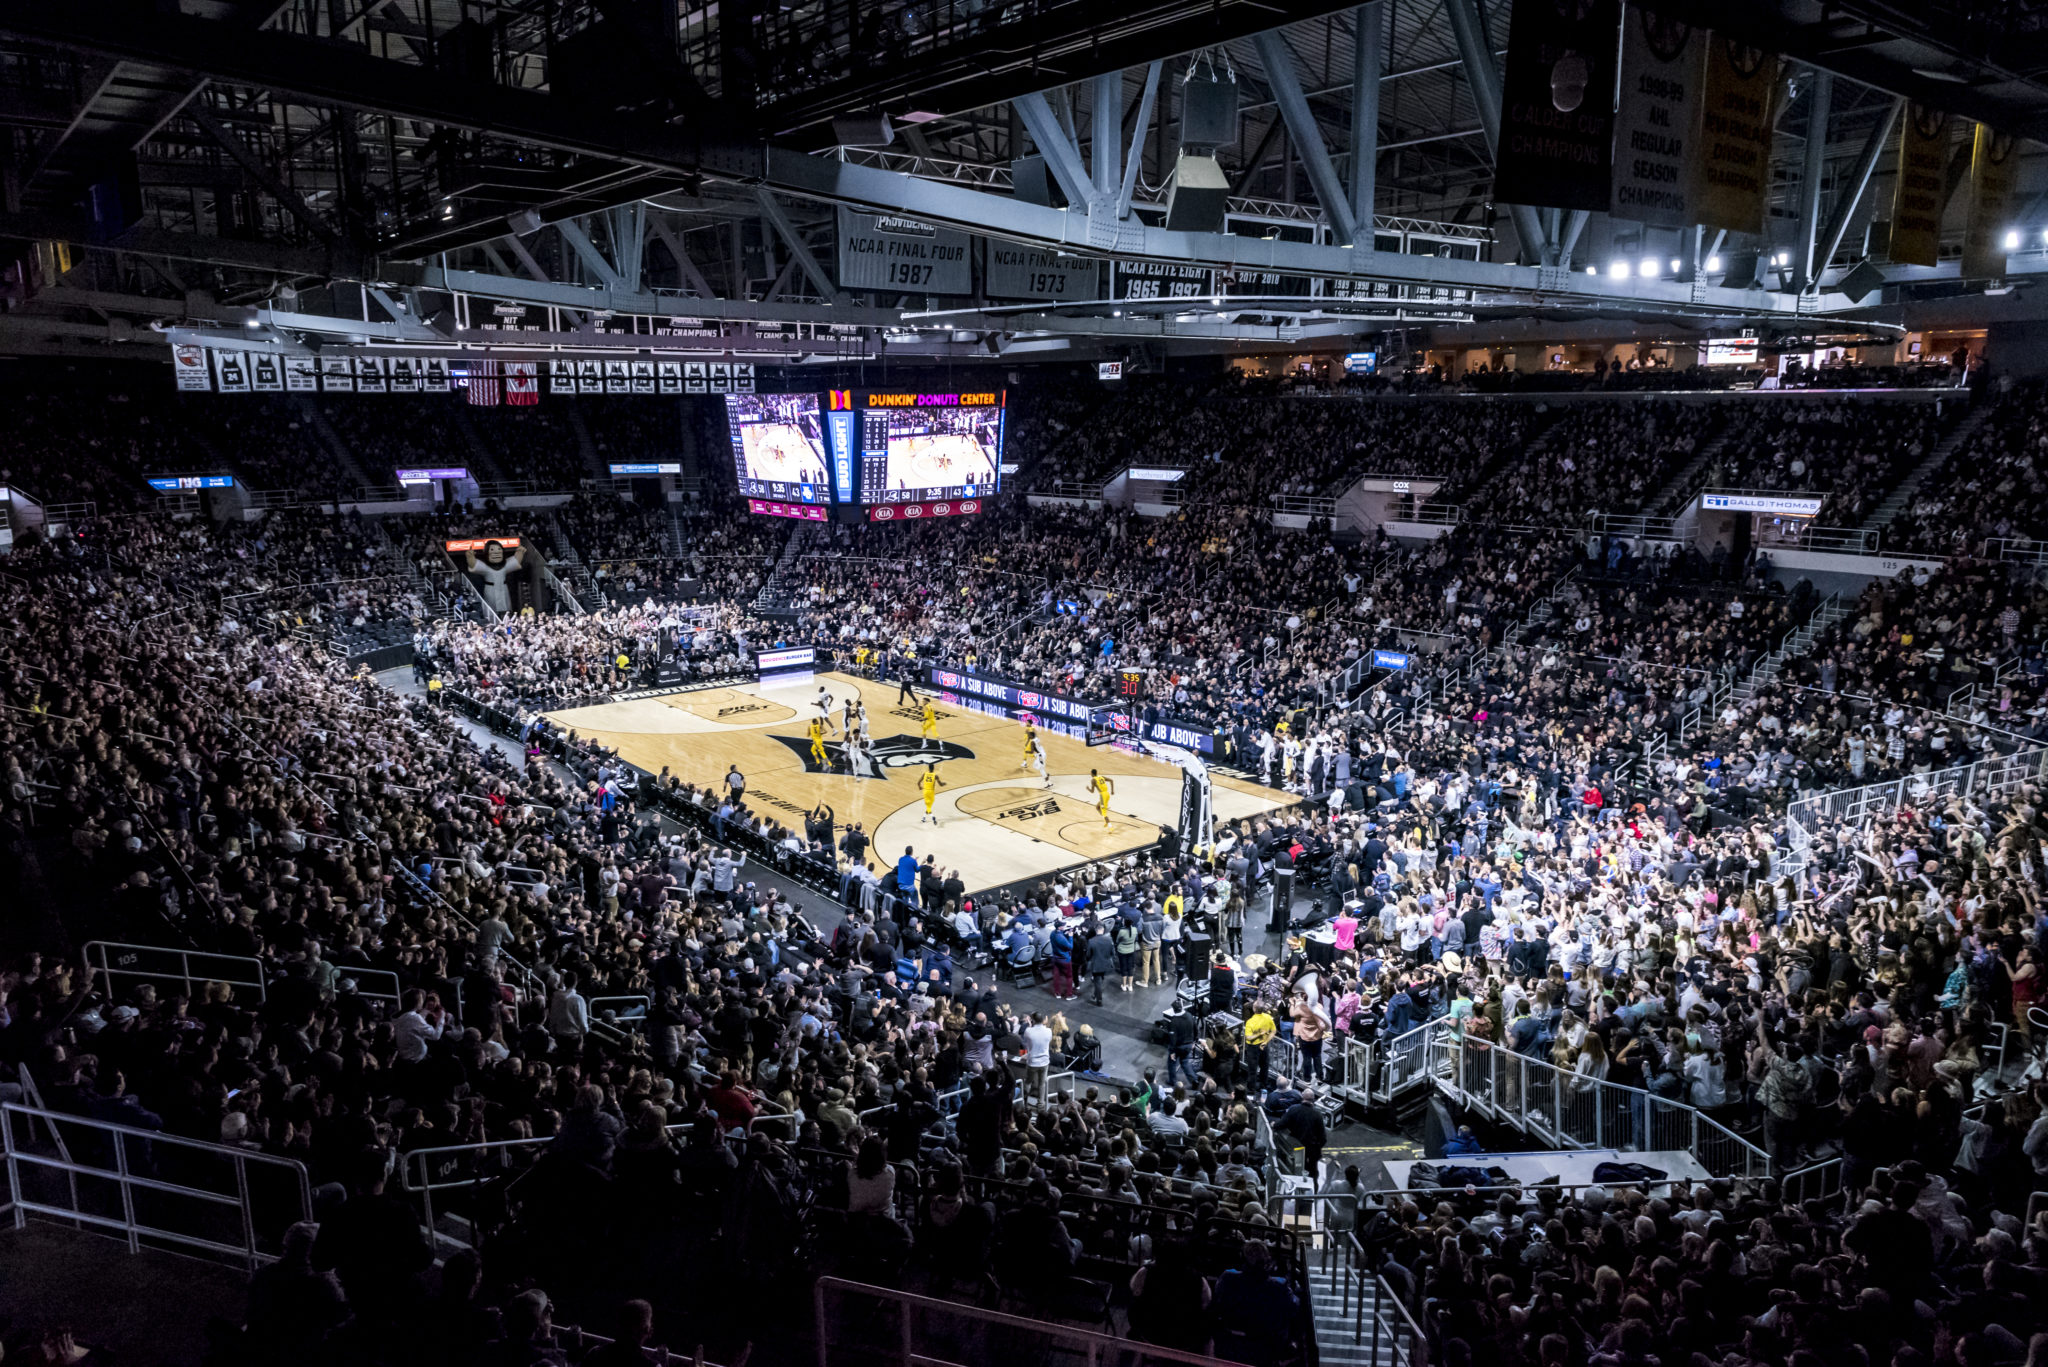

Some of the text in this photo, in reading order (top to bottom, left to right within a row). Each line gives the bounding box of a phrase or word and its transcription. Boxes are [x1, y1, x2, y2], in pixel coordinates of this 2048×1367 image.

[1512, 103, 1605, 135] CALDER CUP
[1649, 106, 1671, 127] AHL
[1512, 136, 1601, 165] CHAMPIONS
[1631, 131, 1683, 156] REGULAR
[1633, 160, 1678, 183] SEASON
[1618, 186, 1685, 211] CHAMPIONS
[848, 237, 963, 261] NCAA FINAL FOUR
[995, 251, 1025, 266] NCAA
[888, 262, 933, 285] 1987
[1119, 261, 1207, 279] NCAA ELITE EIGHT
[1028, 273, 1065, 293] 1973
[1239, 272, 1280, 285] 2017 2018
[1127, 279, 1201, 298] 1965 1997
[656, 328, 717, 337] NIT CHAMPIONS
[227, 373, 238, 381] 24
[262, 372, 272, 380] 14
[869, 393, 995, 406] DUNKIN' DONUTS CENTER
[835, 419, 847, 459] LIGHT
[838, 461, 849, 488] BUD
[773, 483, 785, 492] 9:35
[792, 488, 800, 496] 43
[927, 488, 942, 496] 9:35
[901, 492, 911, 500] 58
[906, 507, 920, 516] KIA
[935, 505, 948, 515] KIA
[963, 502, 975, 512] KIA
[1730, 499, 1765, 507] GALLO
[1770, 501, 1817, 509] THOMAS
[877, 508, 892, 519] KIA
[1882, 561, 1897, 569] 125
[611, 680, 748, 703] PROVIDENCE
[961, 677, 1009, 700] A SUB ABOVE
[1121, 681, 1137, 695] 30
[1043, 697, 1050, 711] A
[1051, 699, 1067, 715] SUB
[1170, 727, 1200, 749] ABOVE
[745, 790, 779, 802] DAVE
[1018, 806, 1062, 821] BIG
[118, 953, 137, 965] 105
[438, 1158, 458, 1177] 104
